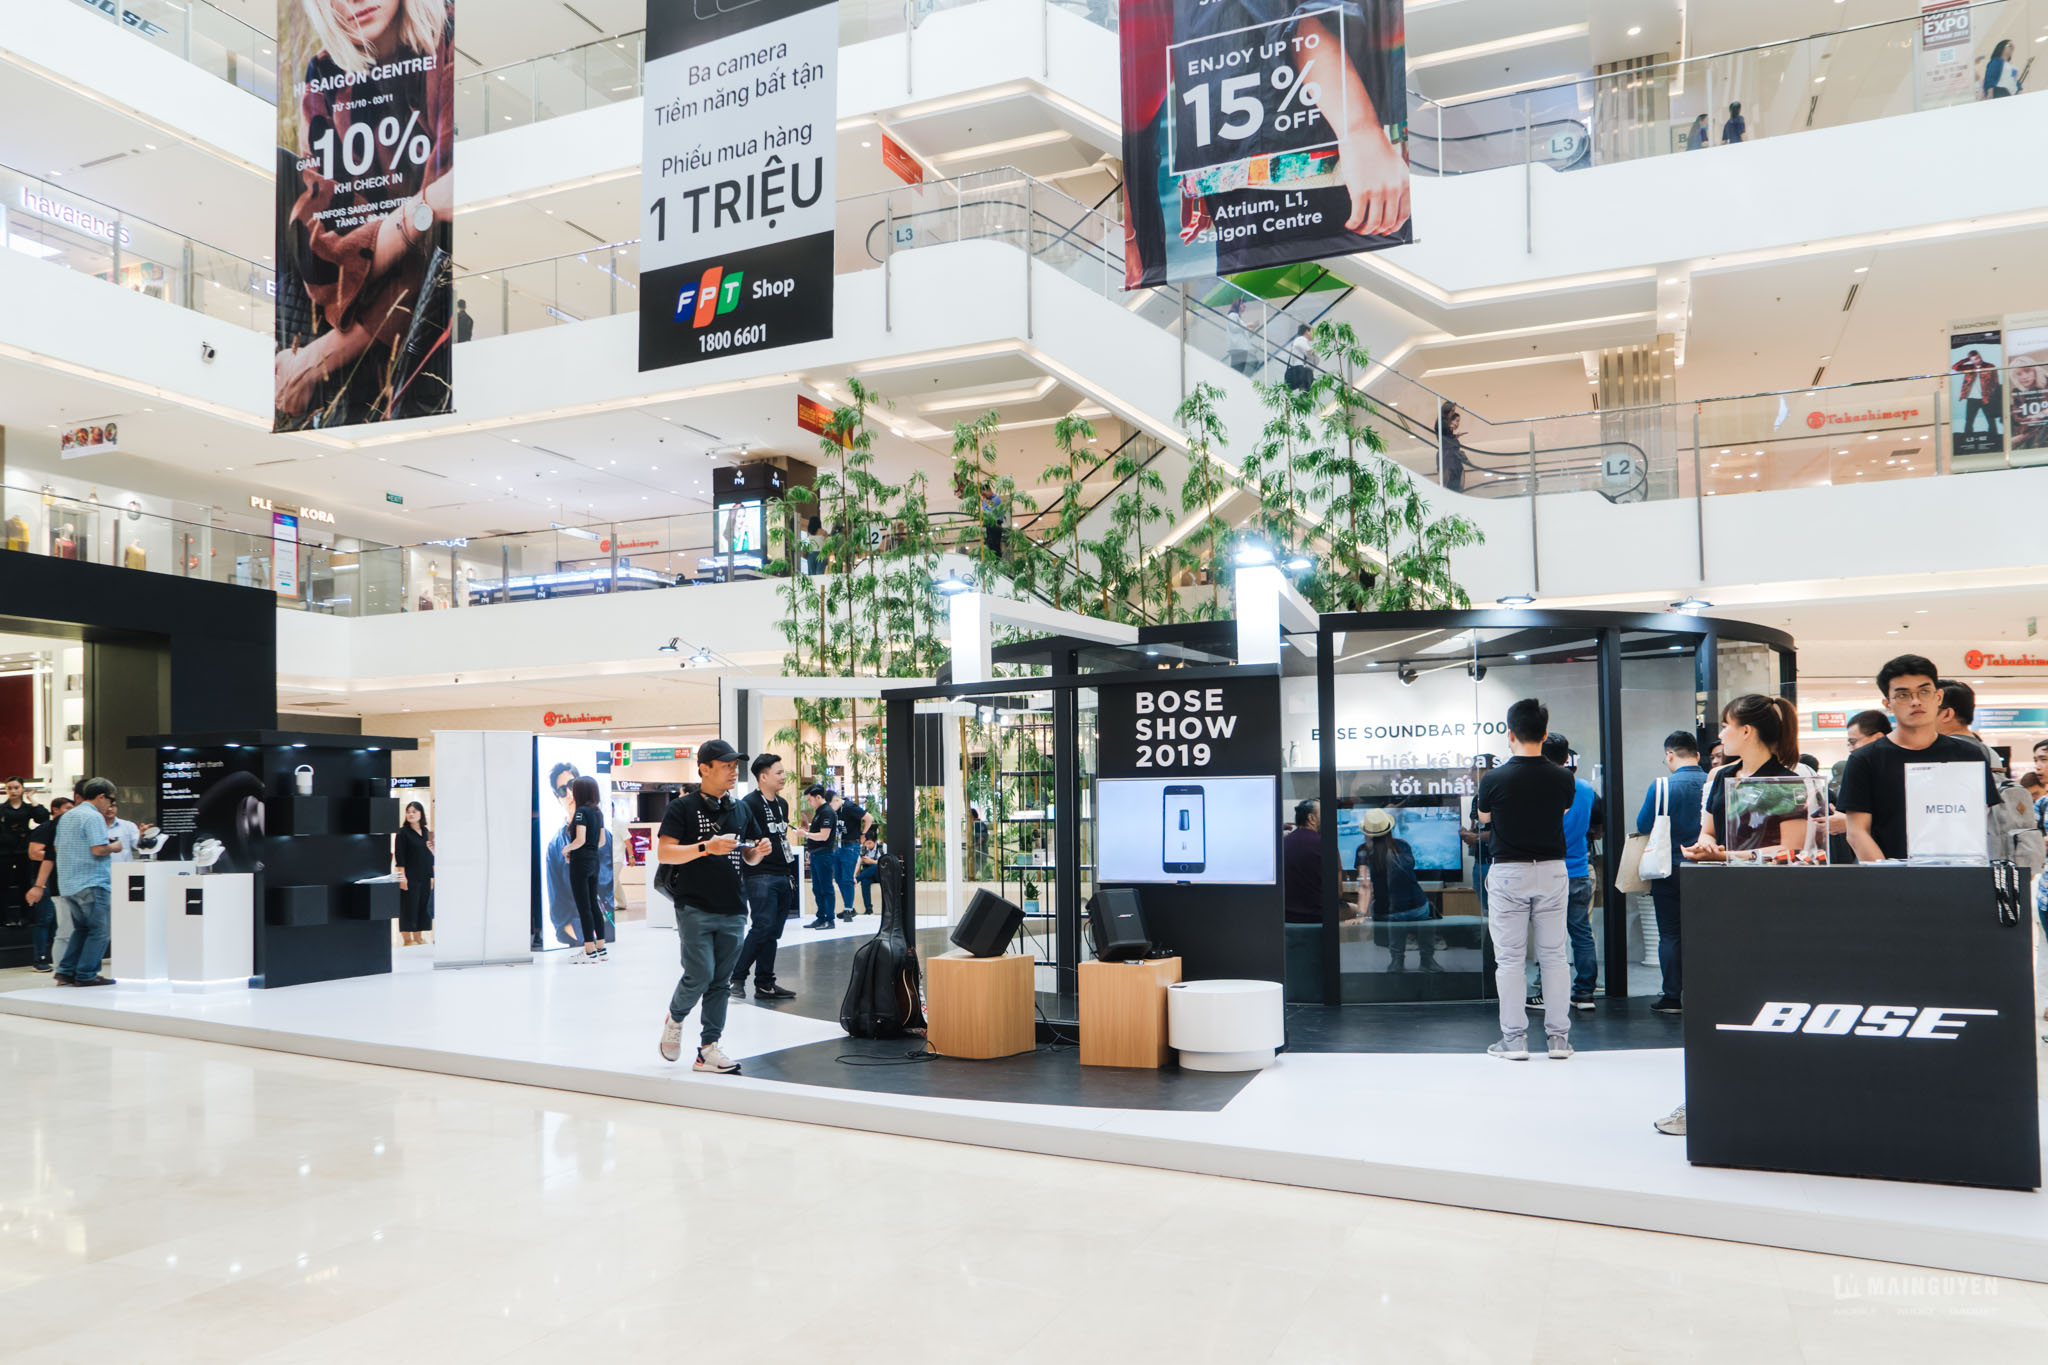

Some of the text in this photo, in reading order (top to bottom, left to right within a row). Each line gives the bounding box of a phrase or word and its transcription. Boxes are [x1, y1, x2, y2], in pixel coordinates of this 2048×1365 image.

[84, 0, 168, 36] OSE
[1924, 15, 1969, 36] EXPO
[688, 43, 787, 86] Ba camera
[1188, 33, 1320, 76] ENJOY UP TO
[293, 56, 437, 98] HI SAIGON CENTRE!
[345, 98, 367, 111] 31/10
[373, 94, 394, 107] 03/11
[655, 62, 824, 126] Tiềm năng bất tận
[1182, 59, 1322, 148] 15%
[1274, 108, 1321, 132] OFF
[313, 110, 431, 180] 10%
[662, 123, 813, 178] Phiếu mua hàng
[1551, 136, 1574, 153] L3
[334, 172, 403, 195] KHI CHECK IN
[347, 201, 379, 216] SAIGON
[650, 197, 666, 241] 1
[683, 154, 823, 234] TRIỆU
[1214, 191, 1309, 221] Atrium, L1,
[23, 187, 130, 244] havaianas
[1197, 210, 1323, 245] Saigon Centre
[896, 228, 914, 243] L3
[752, 278, 795, 299] Shop
[699, 323, 767, 353] 1800 6601
[1828, 408, 1920, 424] Takashimaya
[1606, 459, 1630, 476] L2
[300, 506, 336, 524] KORA
[1136, 688, 1224, 714] BOSE
[556, 713, 613, 725] Takashimaya
[1135, 715, 1238, 741] SHOW
[1312, 721, 1508, 741] BSE SOUNDBAR 700
[1136, 743, 1211, 768] 2019
[1366, 752, 1419, 769] Thiết
[1427, 750, 1451, 769] kế
[1456, 752, 1487, 768] loa
[1390, 776, 1475, 795] tốt nhất
[1925, 804, 1967, 815] MEDIA
[1715, 1001, 1999, 1040] BOSE
